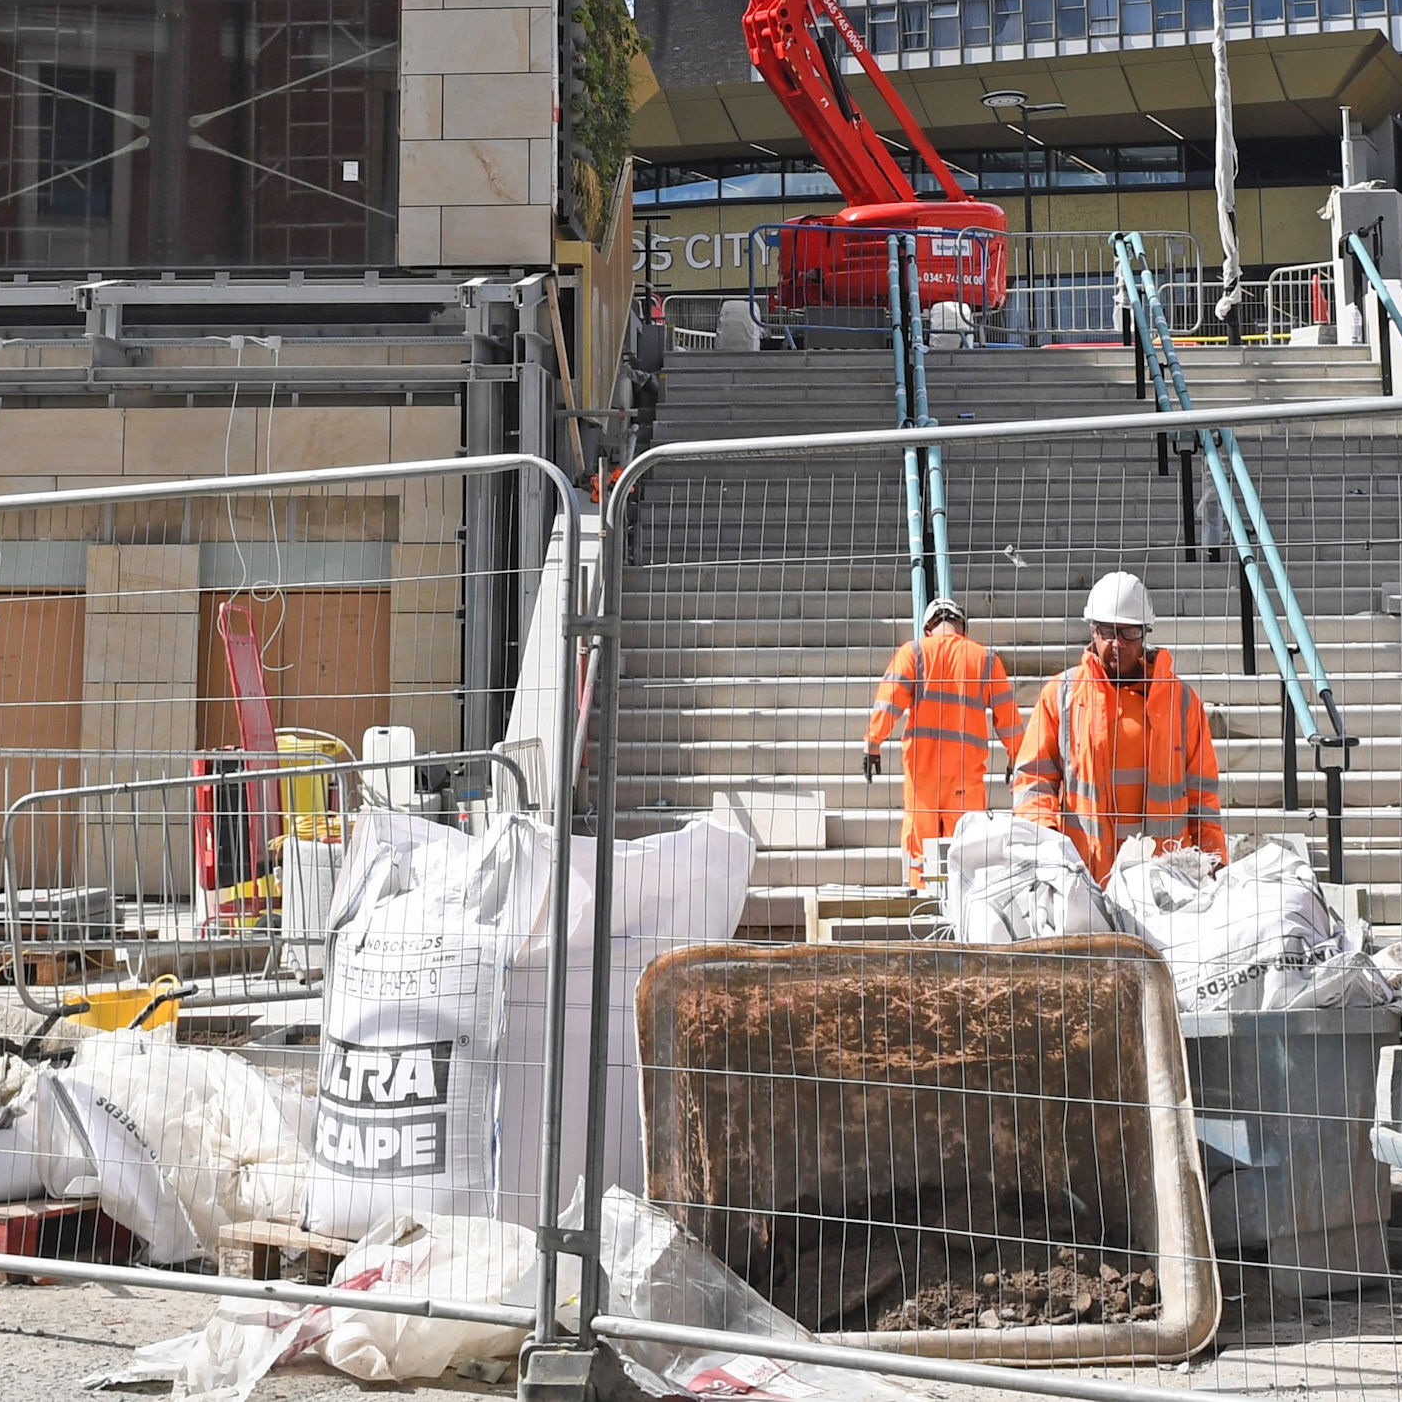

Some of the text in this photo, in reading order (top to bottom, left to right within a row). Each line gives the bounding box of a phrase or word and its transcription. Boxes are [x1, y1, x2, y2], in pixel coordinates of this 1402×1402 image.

[834, 12, 849, 31] 745
[846, 29, 864, 53] 0000
[685, 232, 770, 269] CITY
[923, 272, 944, 283] 0345
[321, 1039, 438, 1103] ULTRA
[315, 1109, 437, 1169] SCAPE
